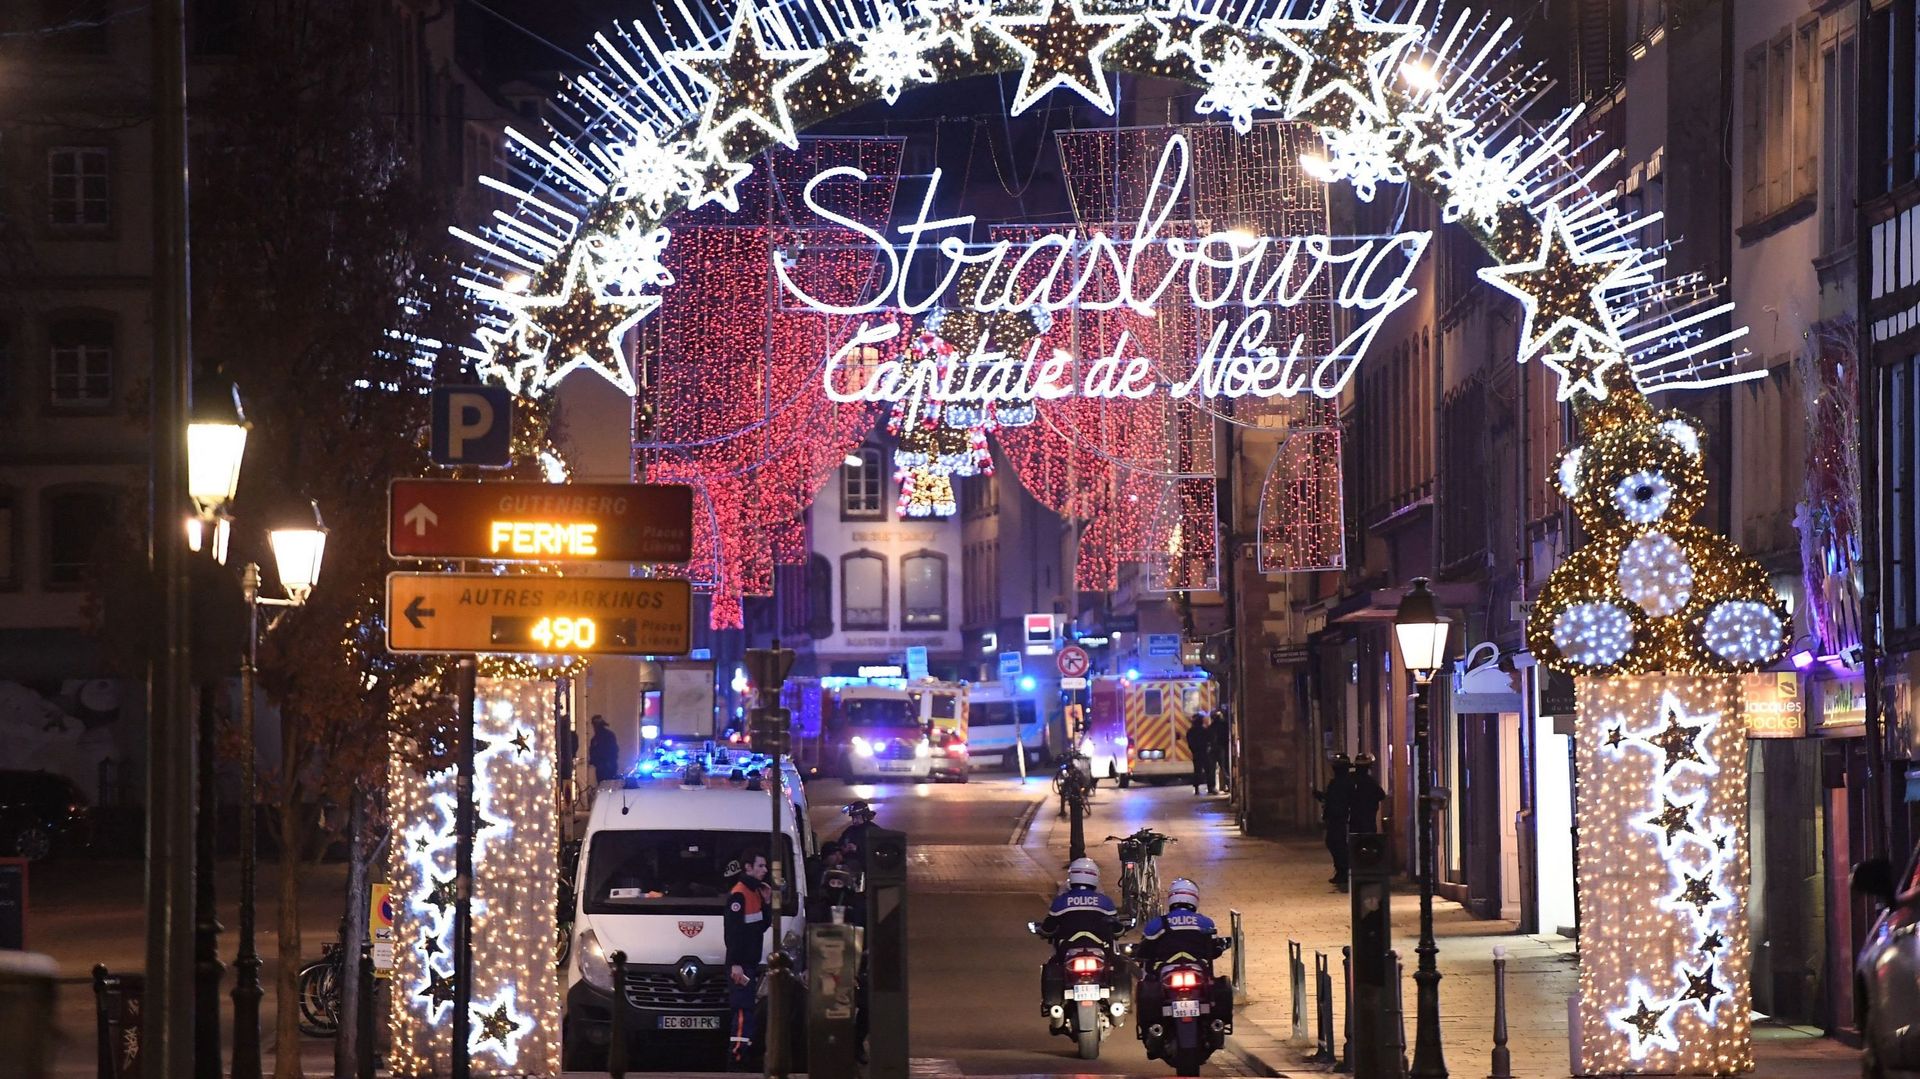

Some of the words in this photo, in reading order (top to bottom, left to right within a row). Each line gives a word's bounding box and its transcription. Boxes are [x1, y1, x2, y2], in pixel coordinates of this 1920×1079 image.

[773, 133, 1434, 400] Strasbourg
[824, 321, 1077, 432] Capitale
[1084, 330, 1156, 399] de
[1171, 309, 1306, 399] Noël
[448, 393, 494, 459] P
[499, 495, 628, 515] GUTENBERG
[490, 520, 598, 555] FERME
[459, 588, 544, 607] AUTRES
[553, 591, 665, 609] PARKINGS
[530, 616, 597, 649] 490
[1067, 896, 1098, 906] POLICE
